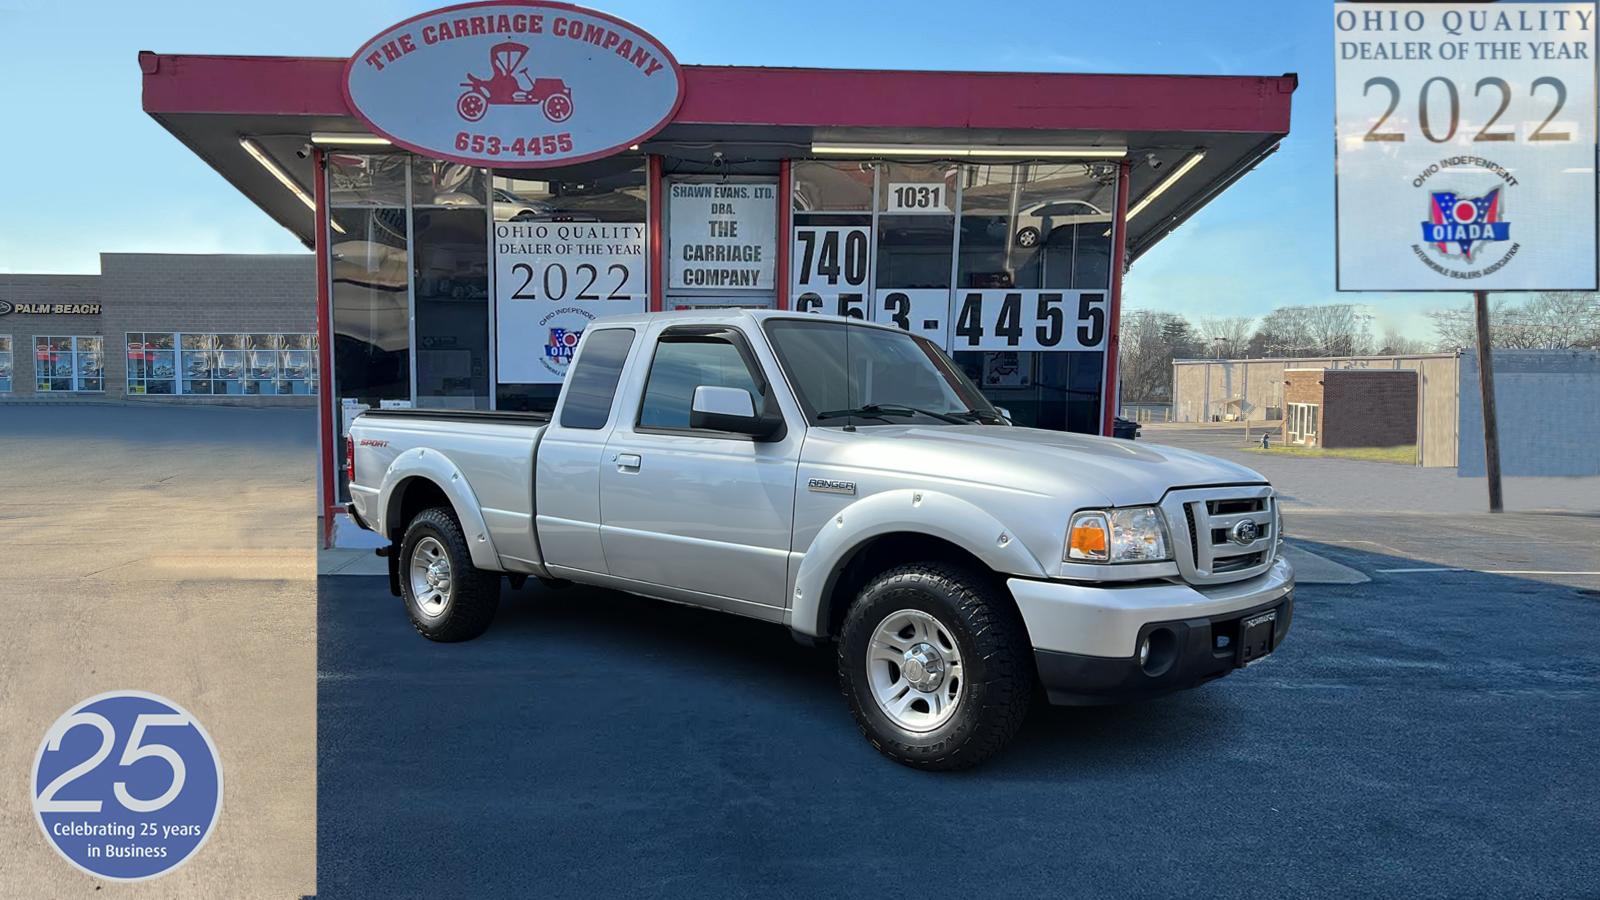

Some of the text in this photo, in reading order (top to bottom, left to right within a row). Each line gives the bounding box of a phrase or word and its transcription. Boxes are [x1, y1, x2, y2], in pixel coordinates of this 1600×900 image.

[1336, 10, 1593, 36] OHIO QUALITY
[365, 14, 664, 77] THE CARRIAGE COMPANY
[1340, 41, 1589, 60] DEALER OF THE YEAR
[1362, 76, 1571, 143] 2022
[454, 132, 573, 157] 653-4455
[1412, 156, 1519, 188] OHIO INDEPENDENT
[672, 185, 712, 199] SHAWN
[754, 186, 775, 200] LTD.
[894, 186, 941, 209] 1031
[711, 203, 736, 215] DBA.
[497, 226, 644, 241] OHIO QUALITY
[708, 220, 738, 238] THE
[1432, 224, 1496, 241] OIADA
[499, 243, 641, 255] DEALER OF THE YEAR
[683, 244, 762, 262] CARRIAGE
[797, 230, 868, 286] 740
[1411, 242, 1520, 280] AUTOMOBILE DEALERS ASSOCIATION
[510, 262, 632, 301] 2022
[683, 268, 761, 287] COMPANY
[15, 303, 100, 314] PALM BEACH
[539, 307, 597, 326] OHIO INDEPENDE
[359, 439, 390, 448] SPORT
[808, 478, 855, 491] RANGER
